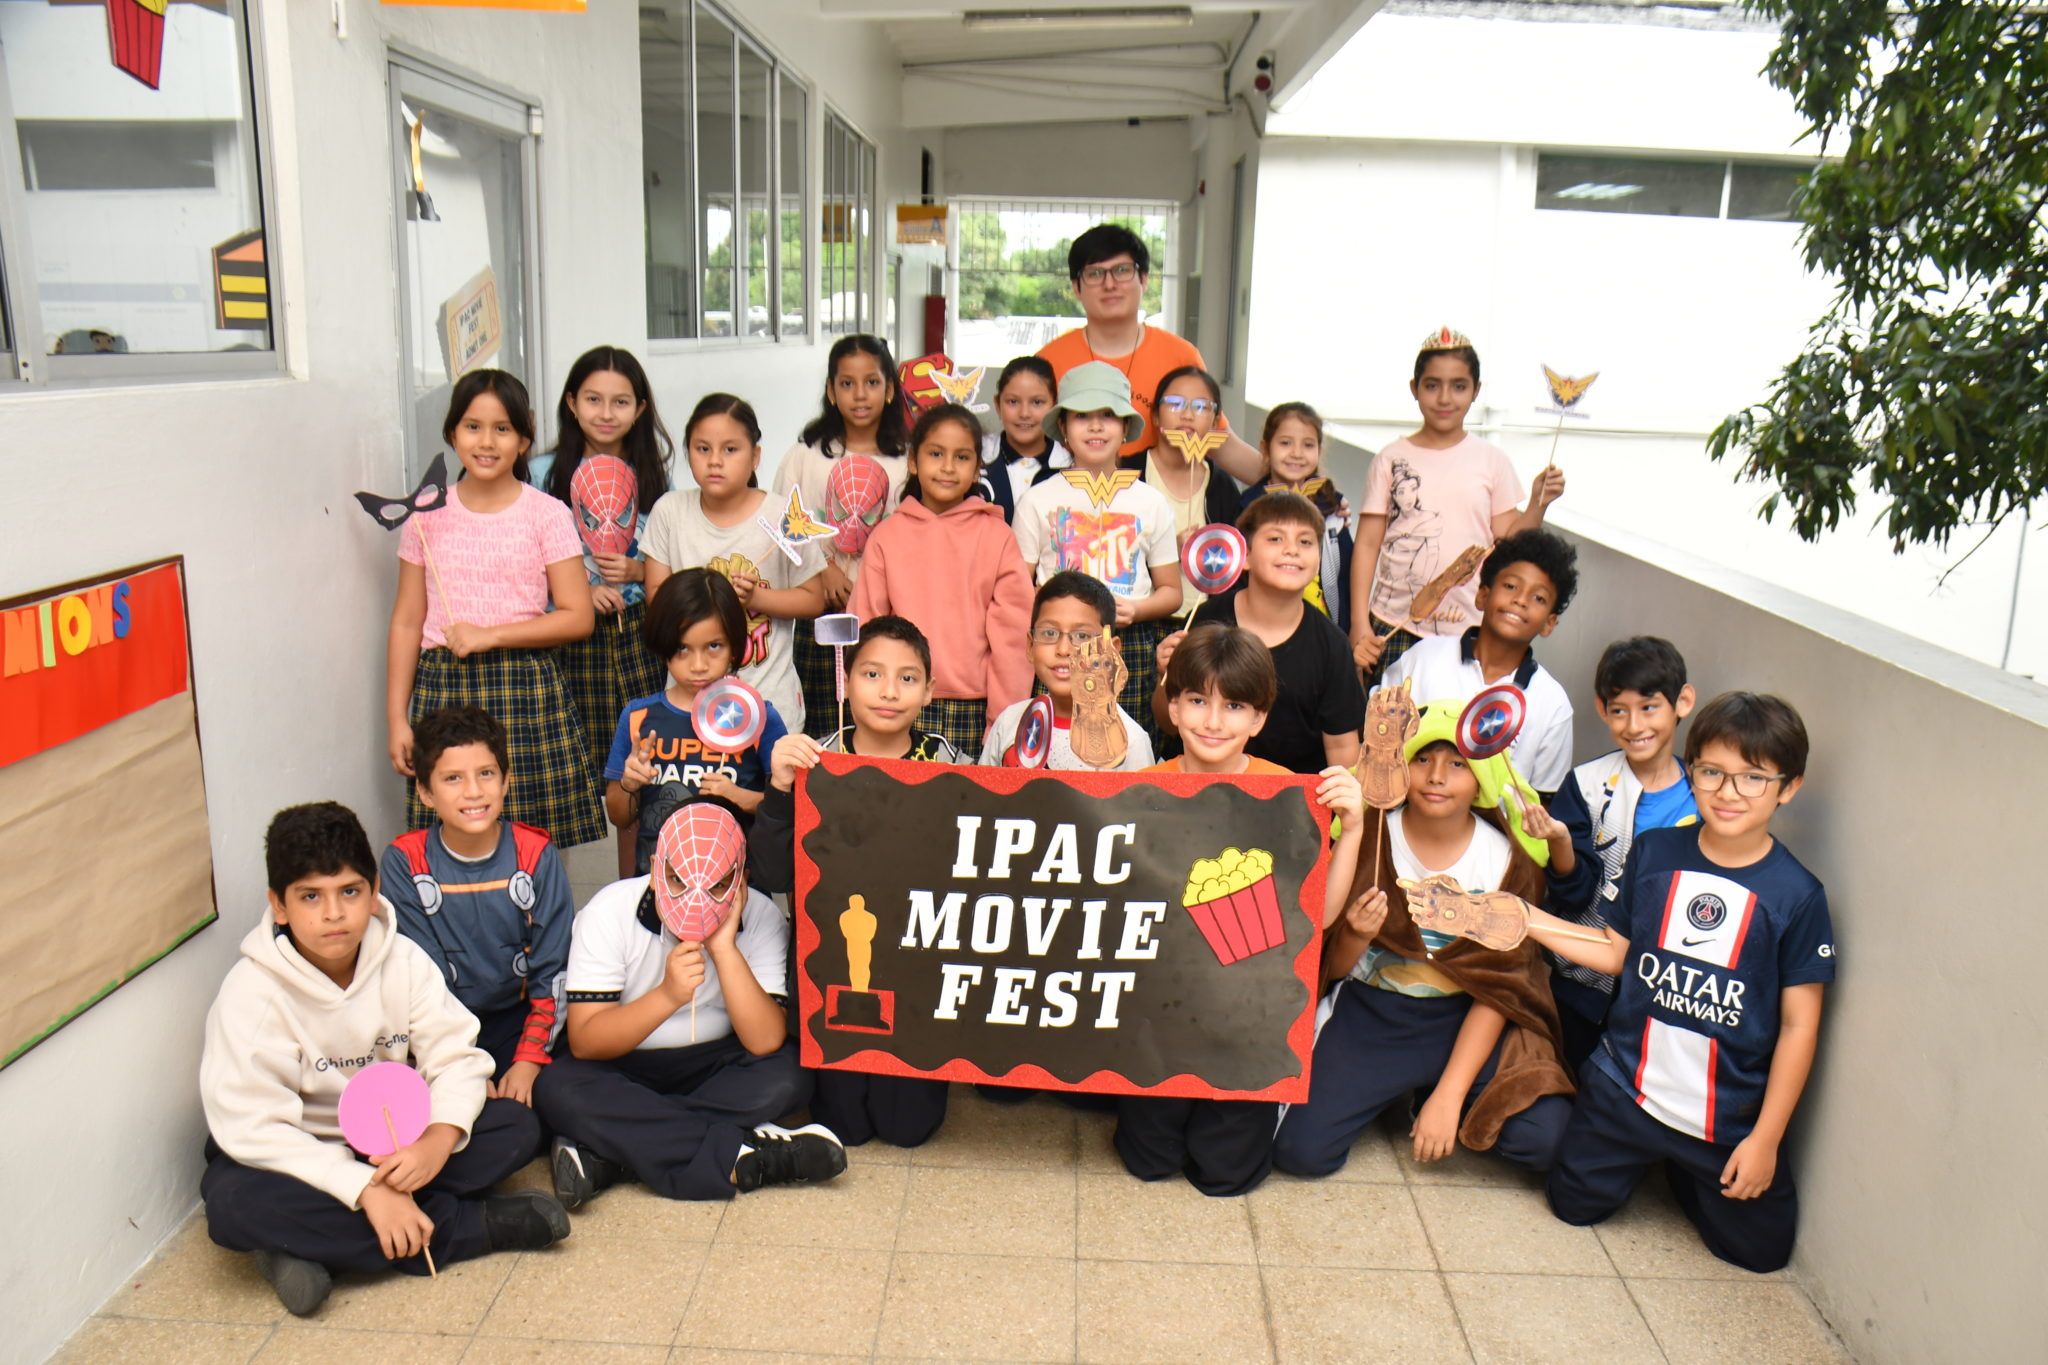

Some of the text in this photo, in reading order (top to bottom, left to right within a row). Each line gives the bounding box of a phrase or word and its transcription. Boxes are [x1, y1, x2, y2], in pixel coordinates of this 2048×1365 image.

[952, 815, 1136, 885] IPAC
[900, 889, 1167, 960] MOVIE
[933, 962, 1136, 1028] FEST
[1638, 952, 1745, 1010] QATAR
[1652, 988, 1741, 1027] AIRWAYS
